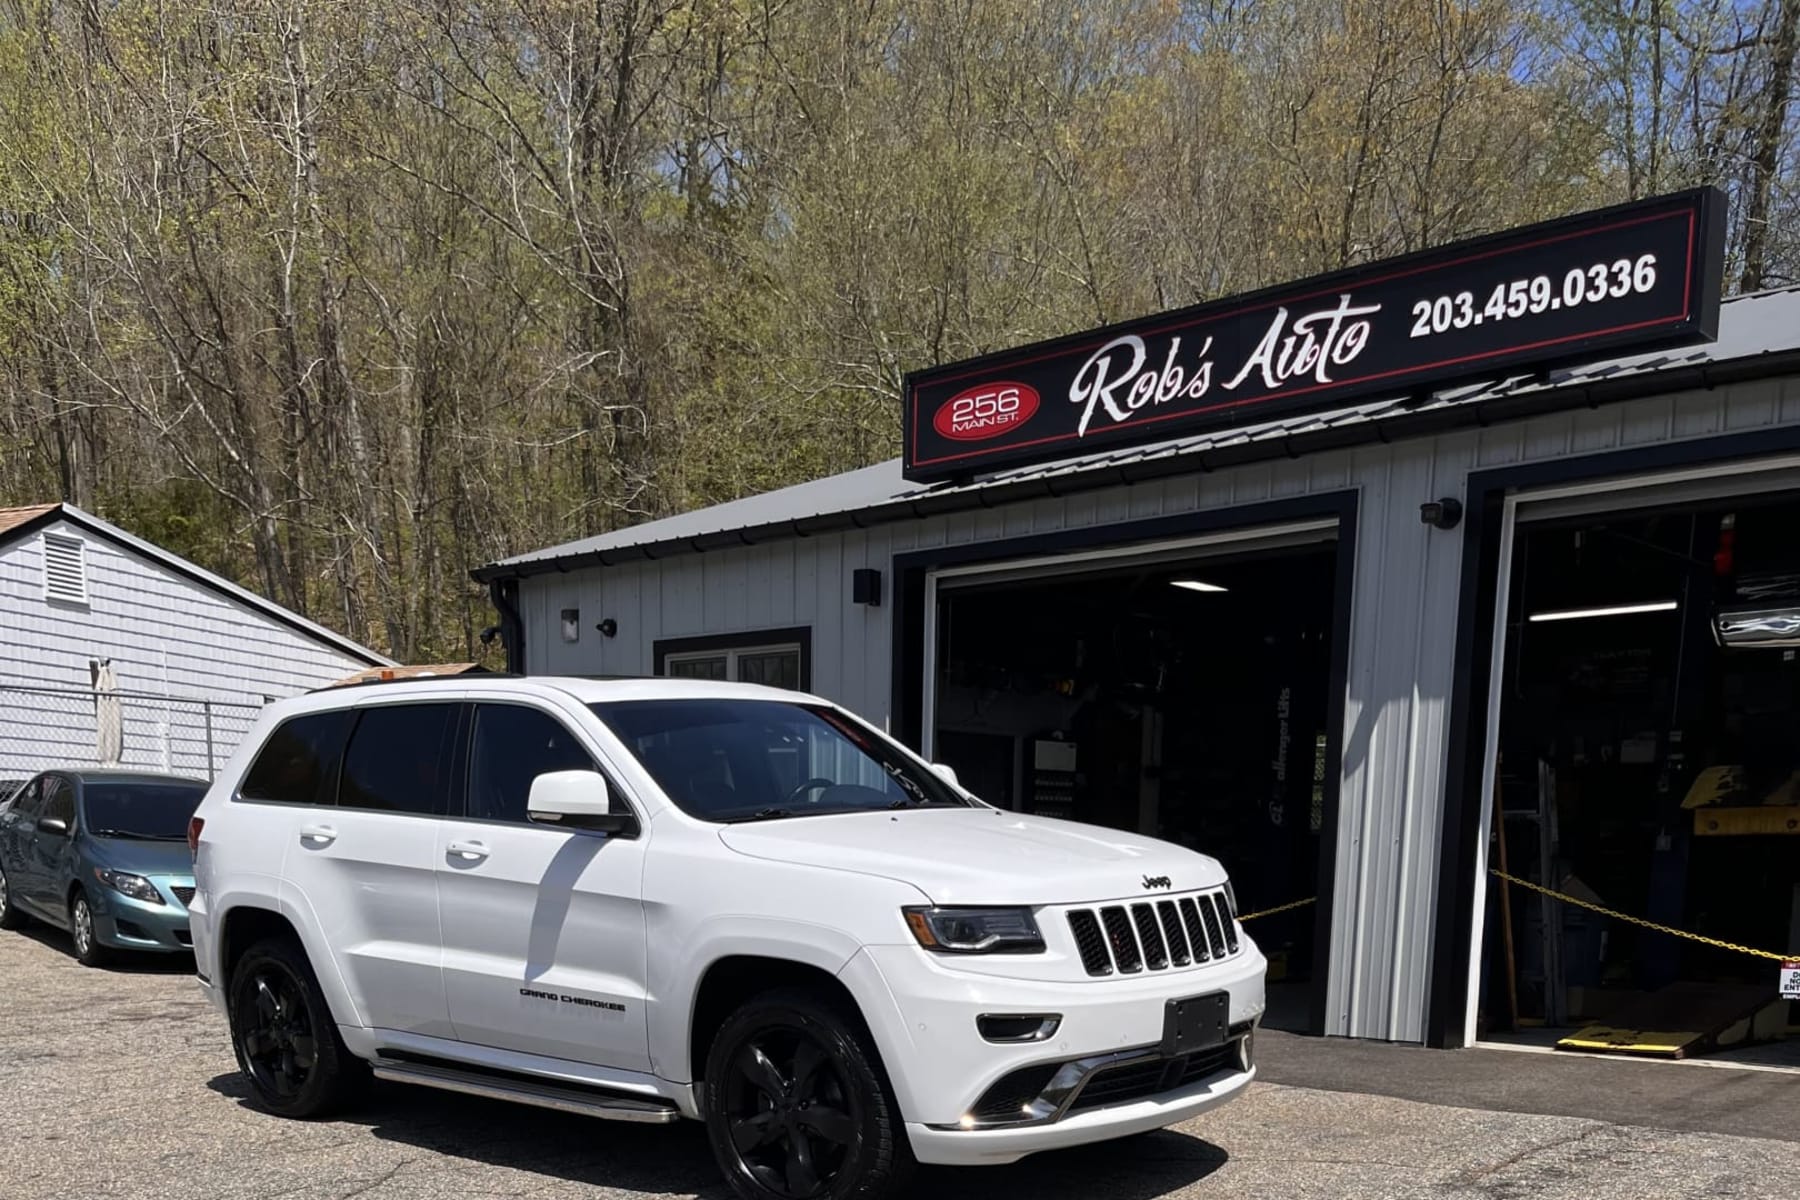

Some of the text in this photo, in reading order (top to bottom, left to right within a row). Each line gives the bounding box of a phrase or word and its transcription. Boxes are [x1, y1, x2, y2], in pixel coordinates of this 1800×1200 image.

[1410, 254, 1657, 338] 203.459.0336
[1069, 294, 1382, 438] Rob's Auto
[952, 388, 1020, 423] 256
[952, 411, 1020, 433] MAIN ST.
[1141, 874, 1172, 890] Jeep
[519, 988, 626, 1012] GRAND CHEROKEE
